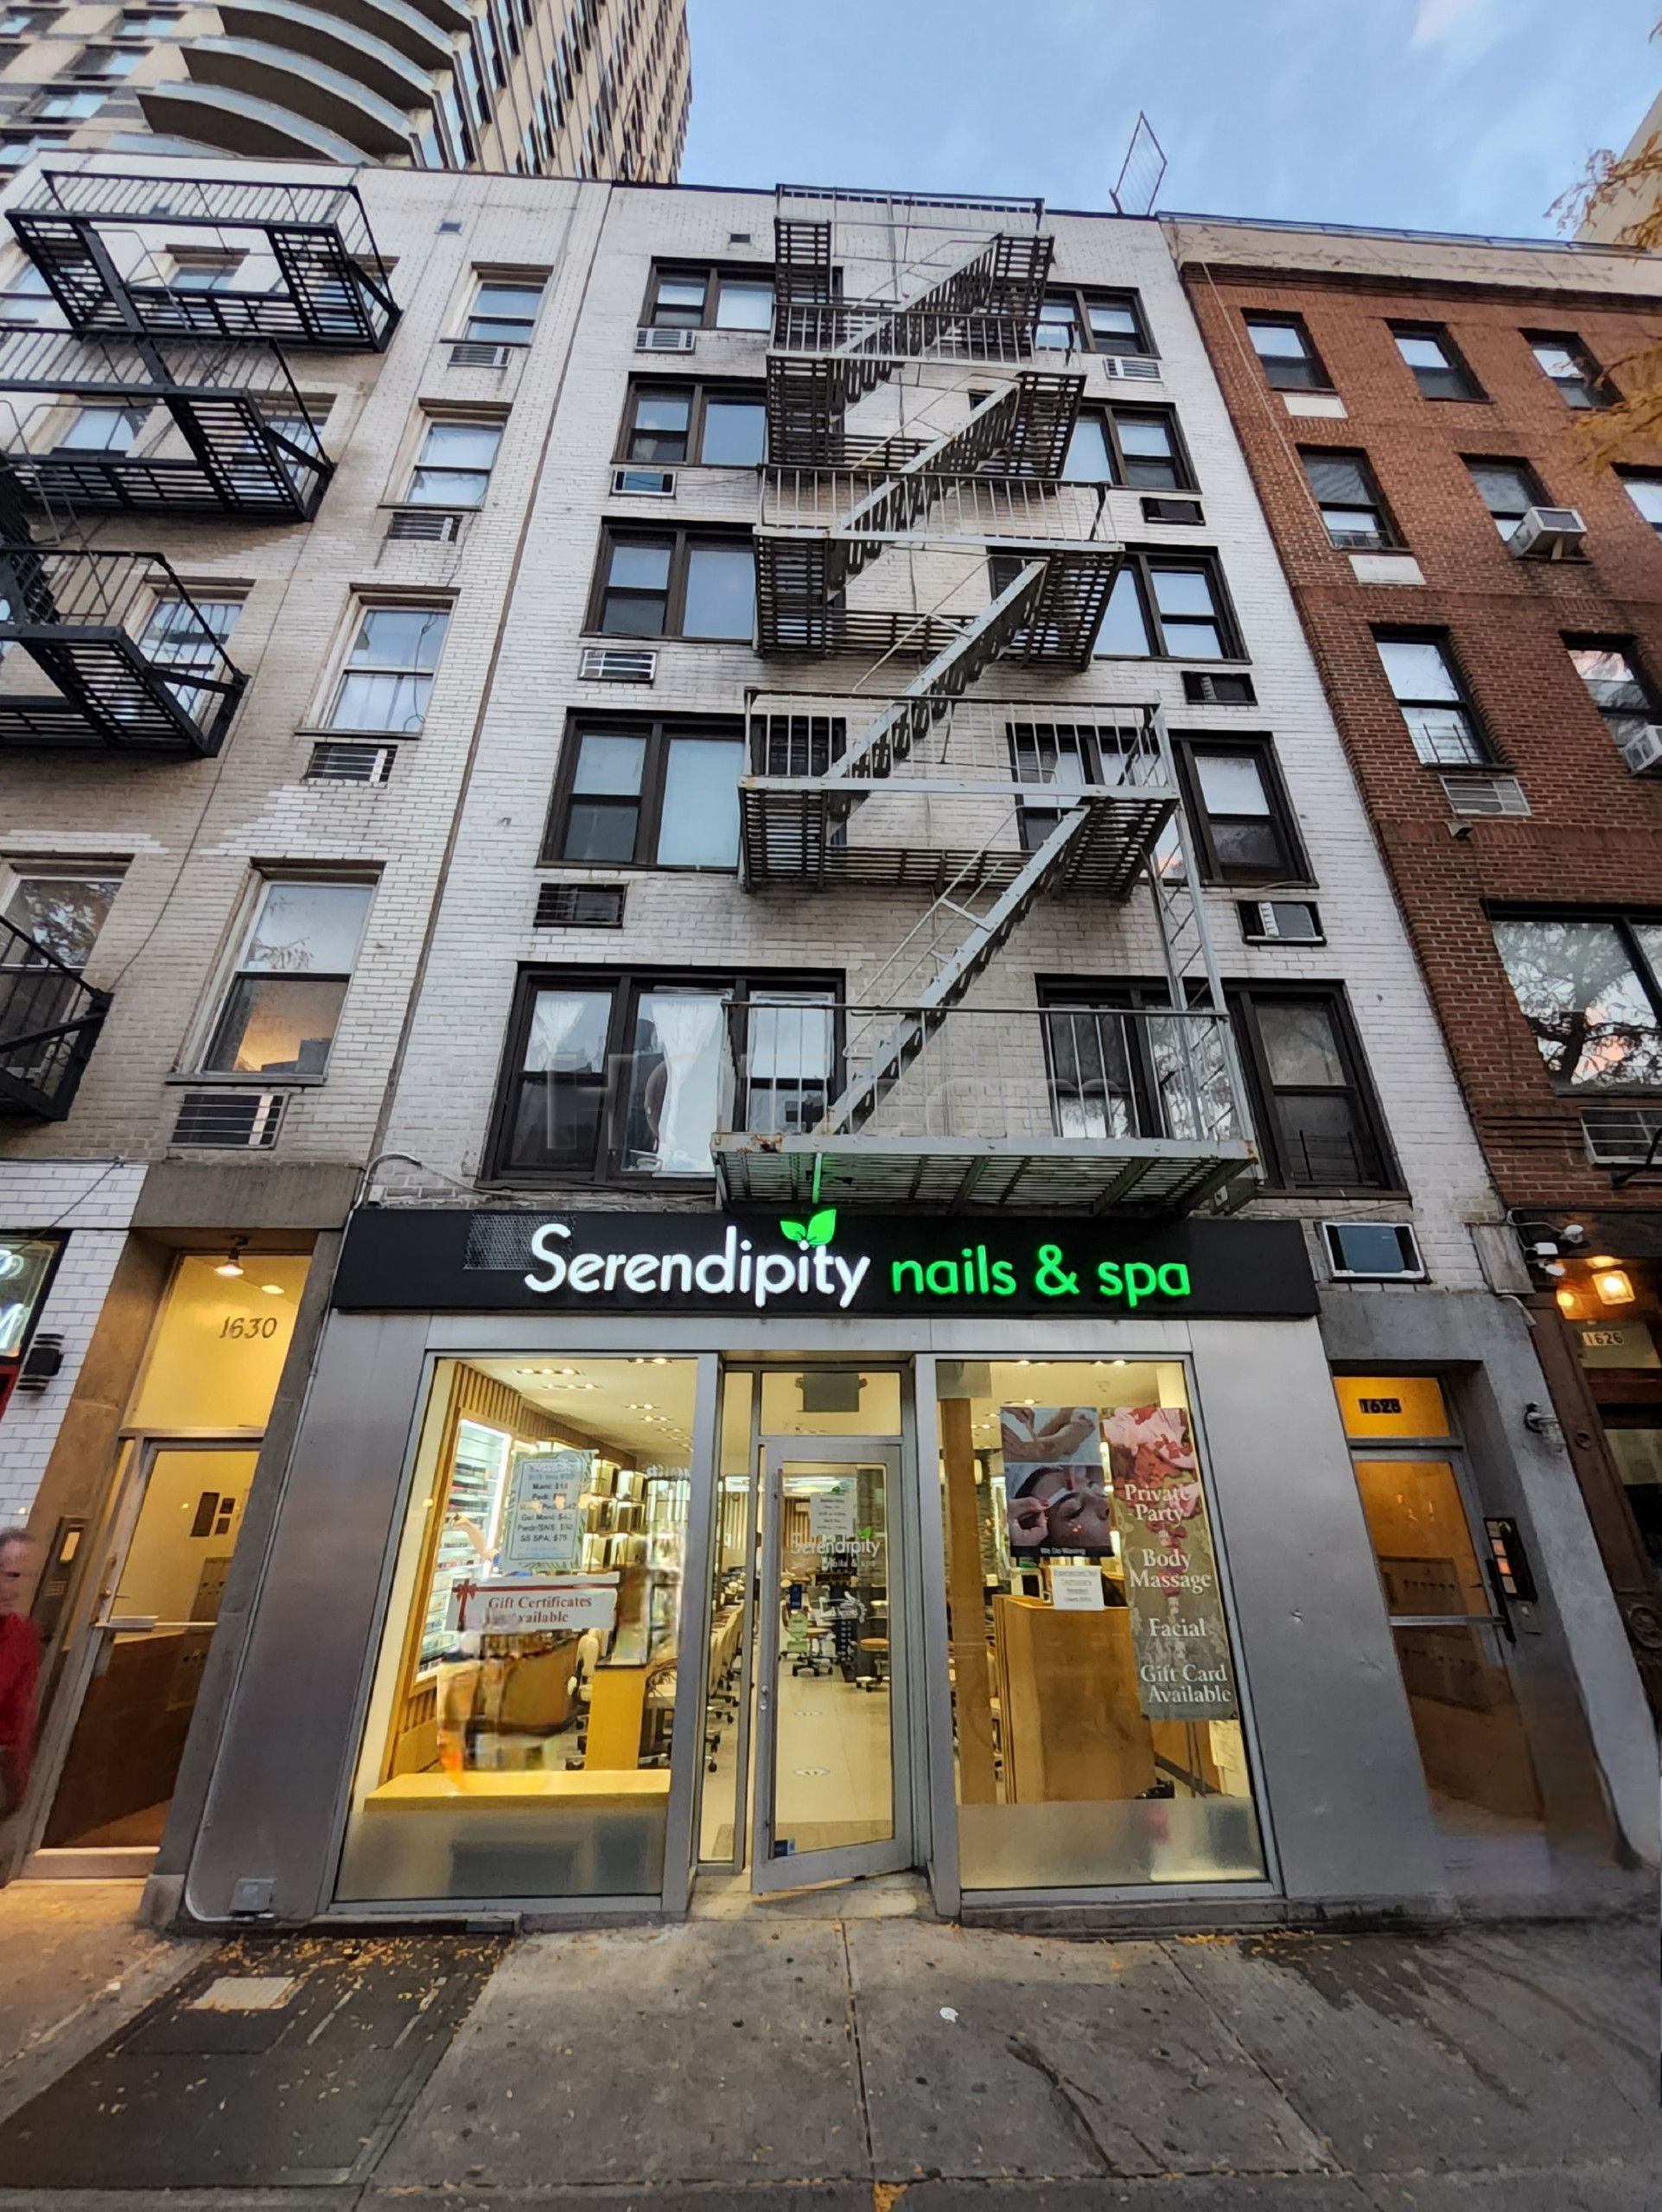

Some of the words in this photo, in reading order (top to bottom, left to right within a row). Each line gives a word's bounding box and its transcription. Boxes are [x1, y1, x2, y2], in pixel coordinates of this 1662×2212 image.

[525, 1223, 871, 1308] Serendipity
[891, 1244, 1016, 1295] nails
[1035, 1244, 1079, 1295] &
[1098, 1262, 1191, 1307] spa
[219, 1315, 278, 1339] 1630
[1583, 1331, 1624, 1346] 1626
[1359, 1398, 1402, 1414] 1628
[1124, 1484, 1191, 1503] Private
[1135, 1503, 1184, 1526] Party
[1143, 1548, 1192, 1571] Body
[1130, 1568, 1212, 1594] Massage
[488, 1596, 515, 1609] Gift
[519, 1595, 593, 1609] Certificates
[1149, 1618, 1207, 1638] Facial
[1140, 1664, 1178, 1684] Gift
[1182, 1664, 1227, 1682] Card
[1148, 1685, 1232, 1704] Available
